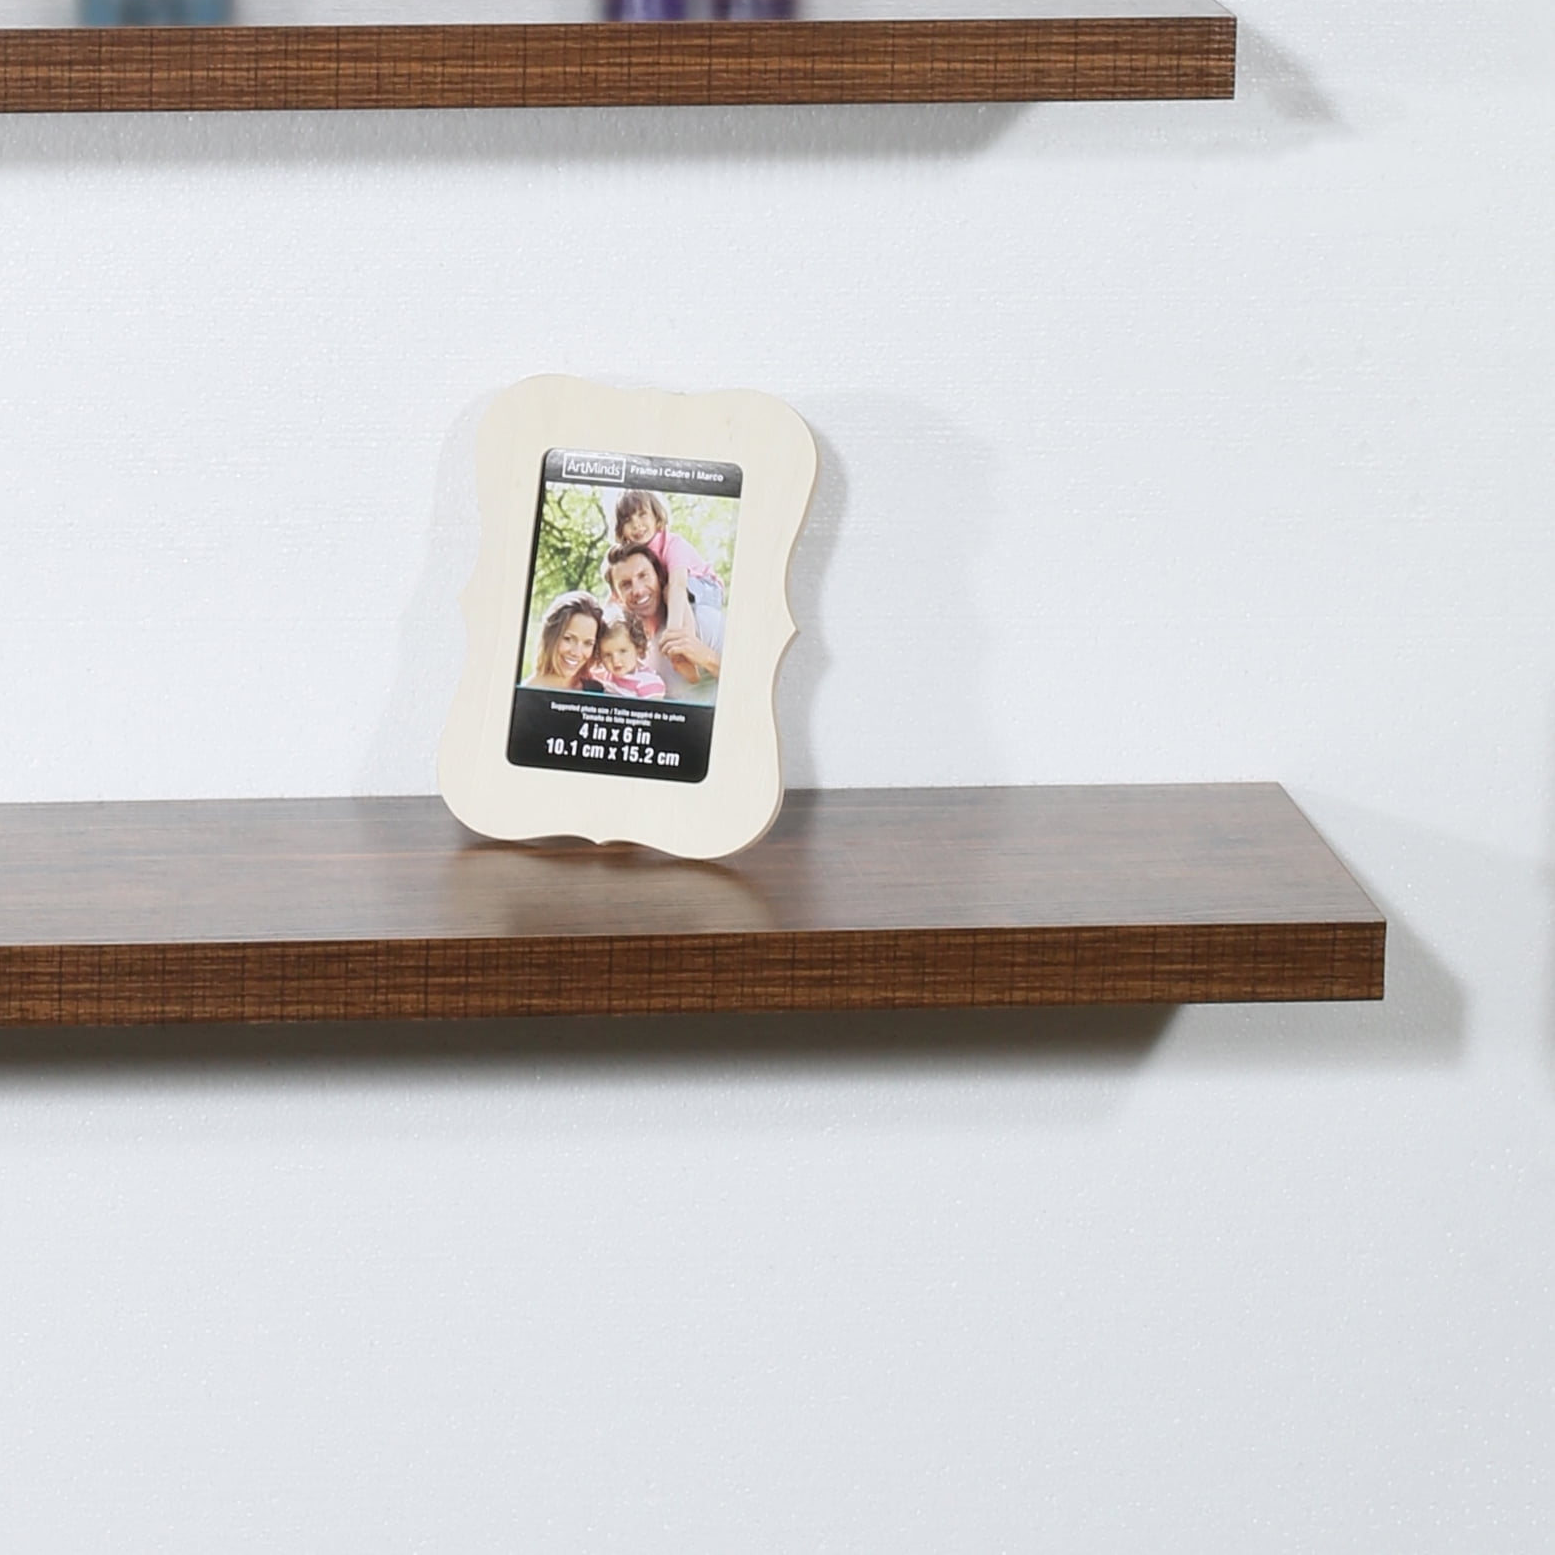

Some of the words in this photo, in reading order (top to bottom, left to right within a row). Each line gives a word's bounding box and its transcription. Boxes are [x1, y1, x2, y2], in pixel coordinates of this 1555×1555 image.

[566, 459, 621, 477] ArtMinds
[630, 465, 659, 478] Frame
[664, 467, 690, 480] Cadre
[696, 470, 724, 483] Marco
[550, 701, 580, 712] Suggested
[581, 704, 597, 714] photo
[668, 713, 686, 723] photo
[578, 722, 589, 739] 4
[593, 724, 607, 741] in
[610, 728, 619, 742] x
[622, 726, 633, 744] 6
[636, 727, 652, 745] in
[546, 737, 578, 755] 10.1
[581, 744, 604, 760] cm
[607, 746, 617, 761] x
[621, 746, 654, 764] 15.2
[657, 751, 680, 767] cm
